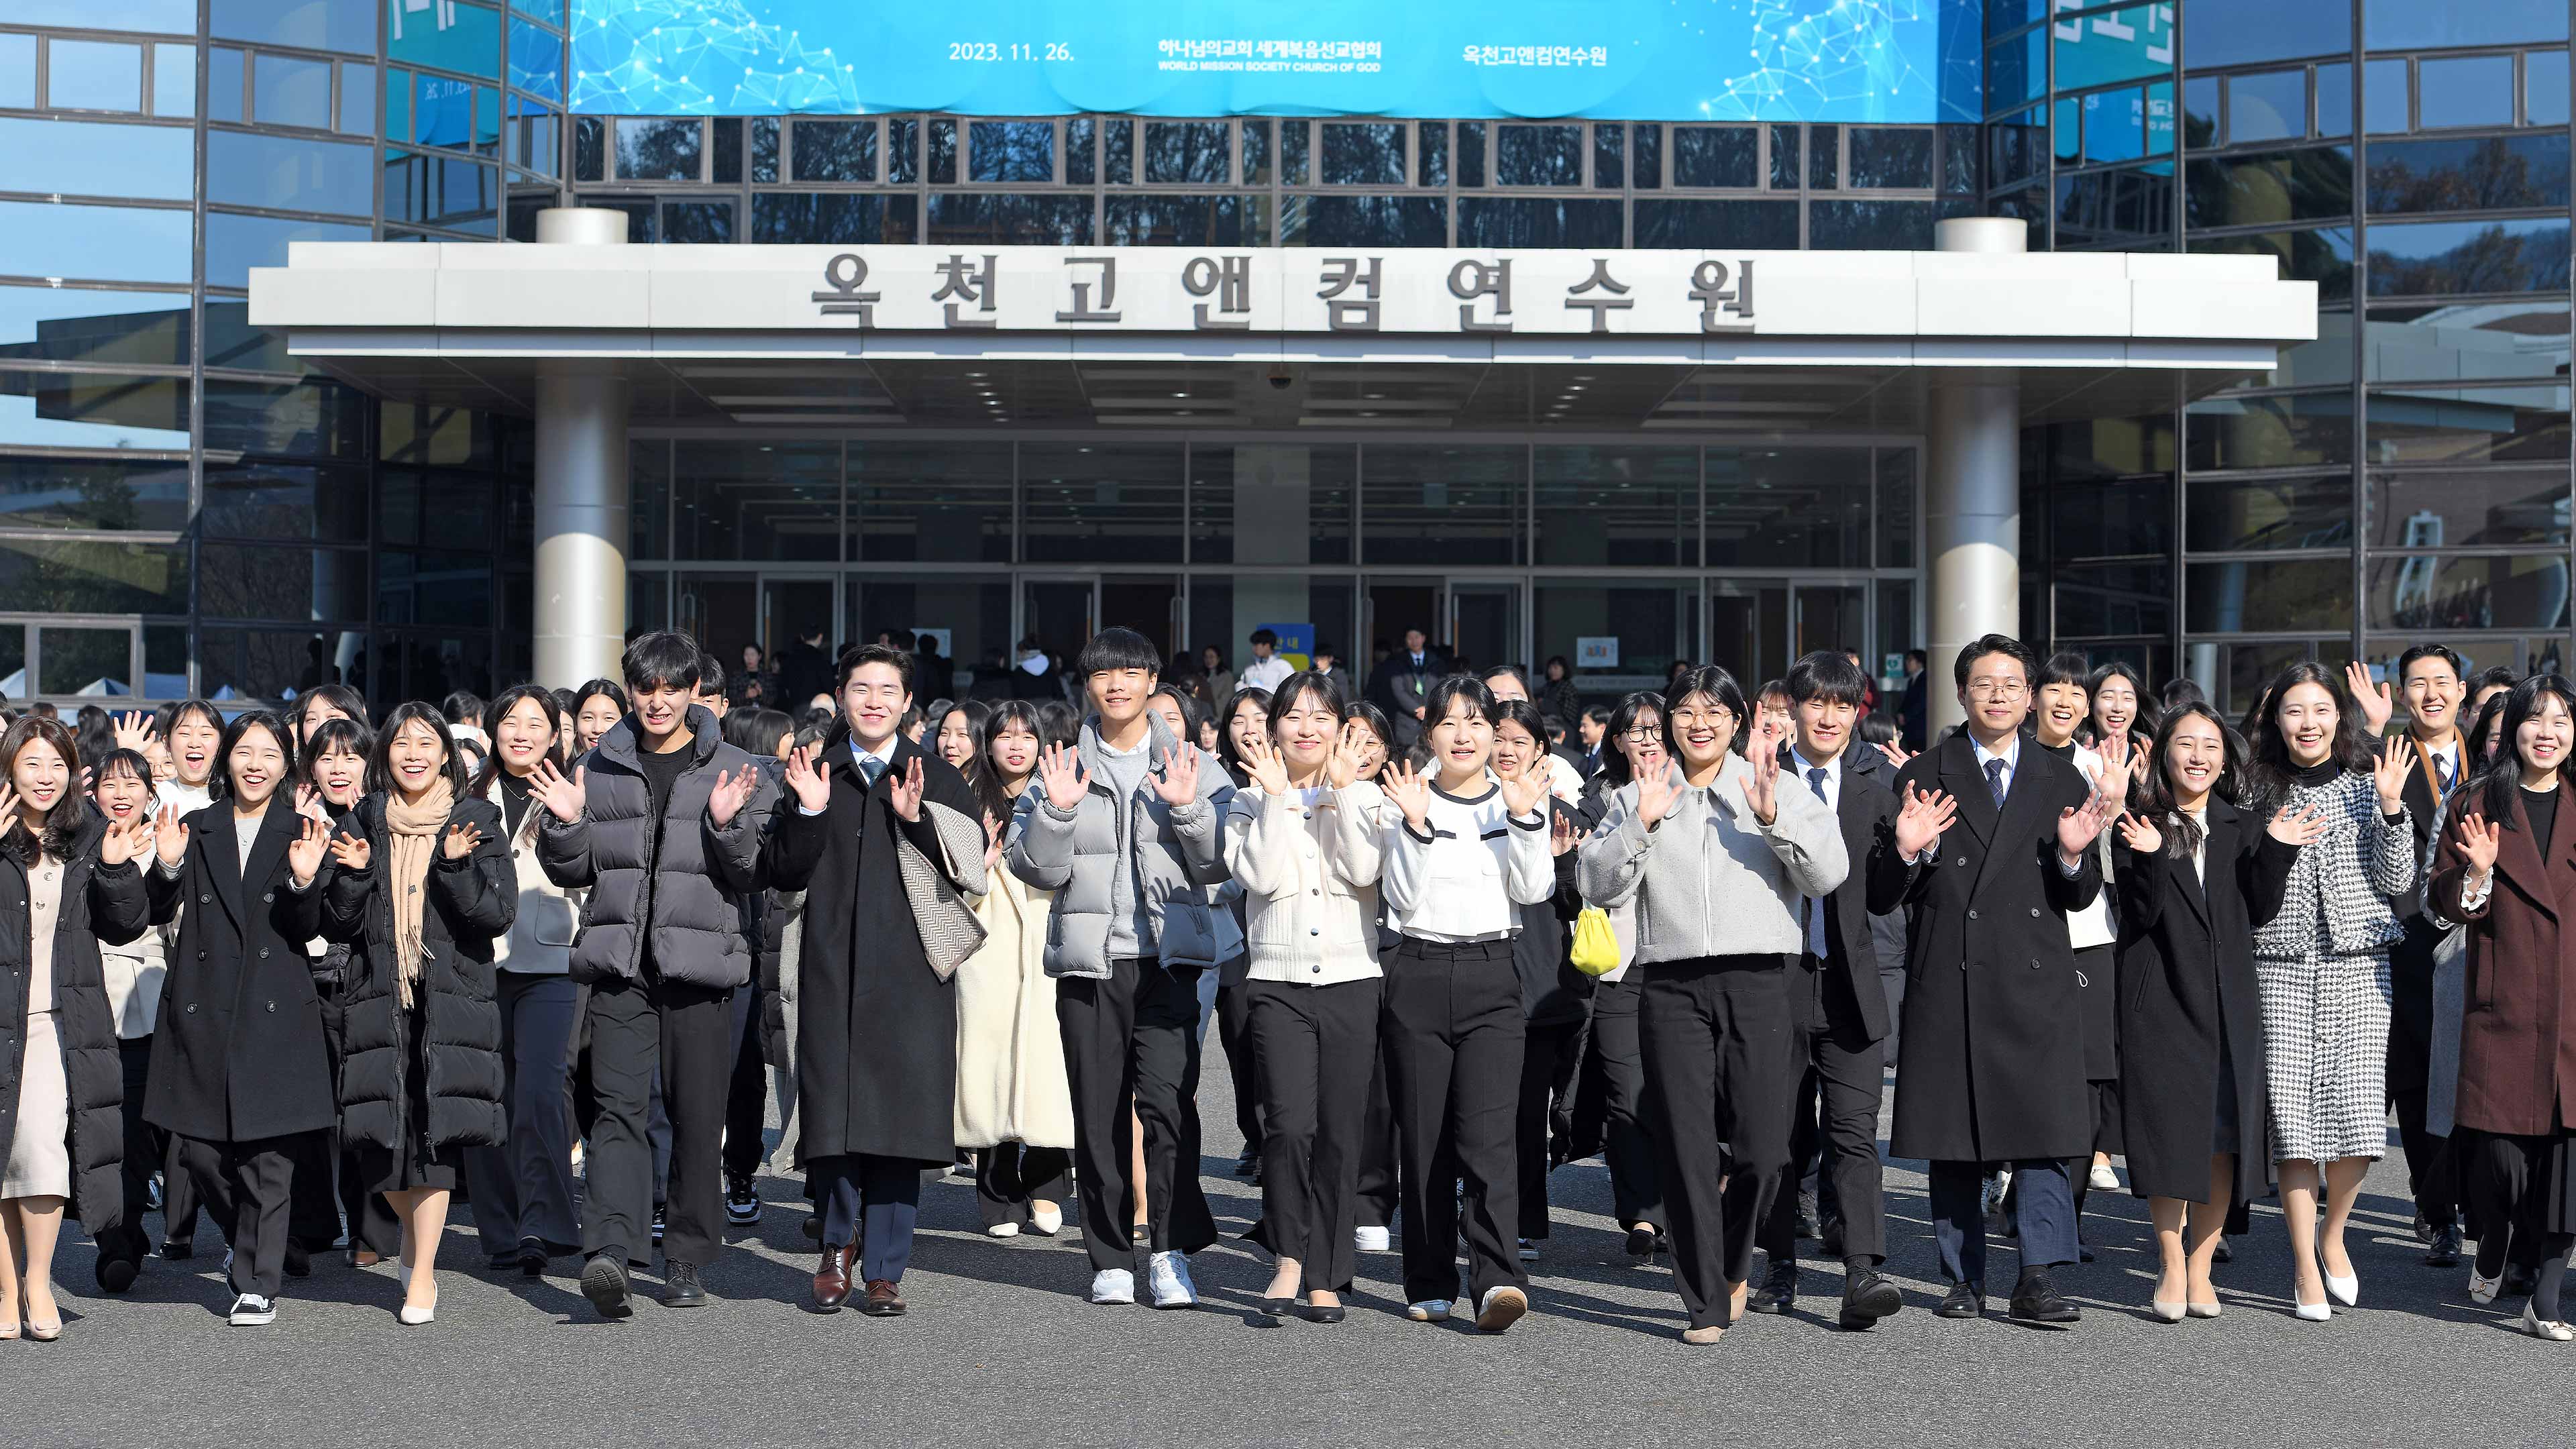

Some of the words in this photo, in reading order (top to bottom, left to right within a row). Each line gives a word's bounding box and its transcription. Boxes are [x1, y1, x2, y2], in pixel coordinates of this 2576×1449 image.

[949, 42, 1002, 61] 2023.
[1011, 43, 1038, 61] 11.
[1046, 42, 1074, 61] 26.
[1159, 40, 1252, 58] 하나님의교회
[1256, 40, 1381, 59] 세계복음선교협회
[1462, 45, 1607, 66] 옥천고앤컴연수원
[1159, 61, 1198, 71] WORLD
[1200, 61, 1244, 71] MISSION
[1246, 62, 1291, 72] SOCIETY
[1293, 62, 1338, 72] CHURCH
[1340, 63, 1354, 72] OF
[1356, 63, 1381, 72] GOD
[812, 254, 1755, 333] 옥천고앤컴연수원
